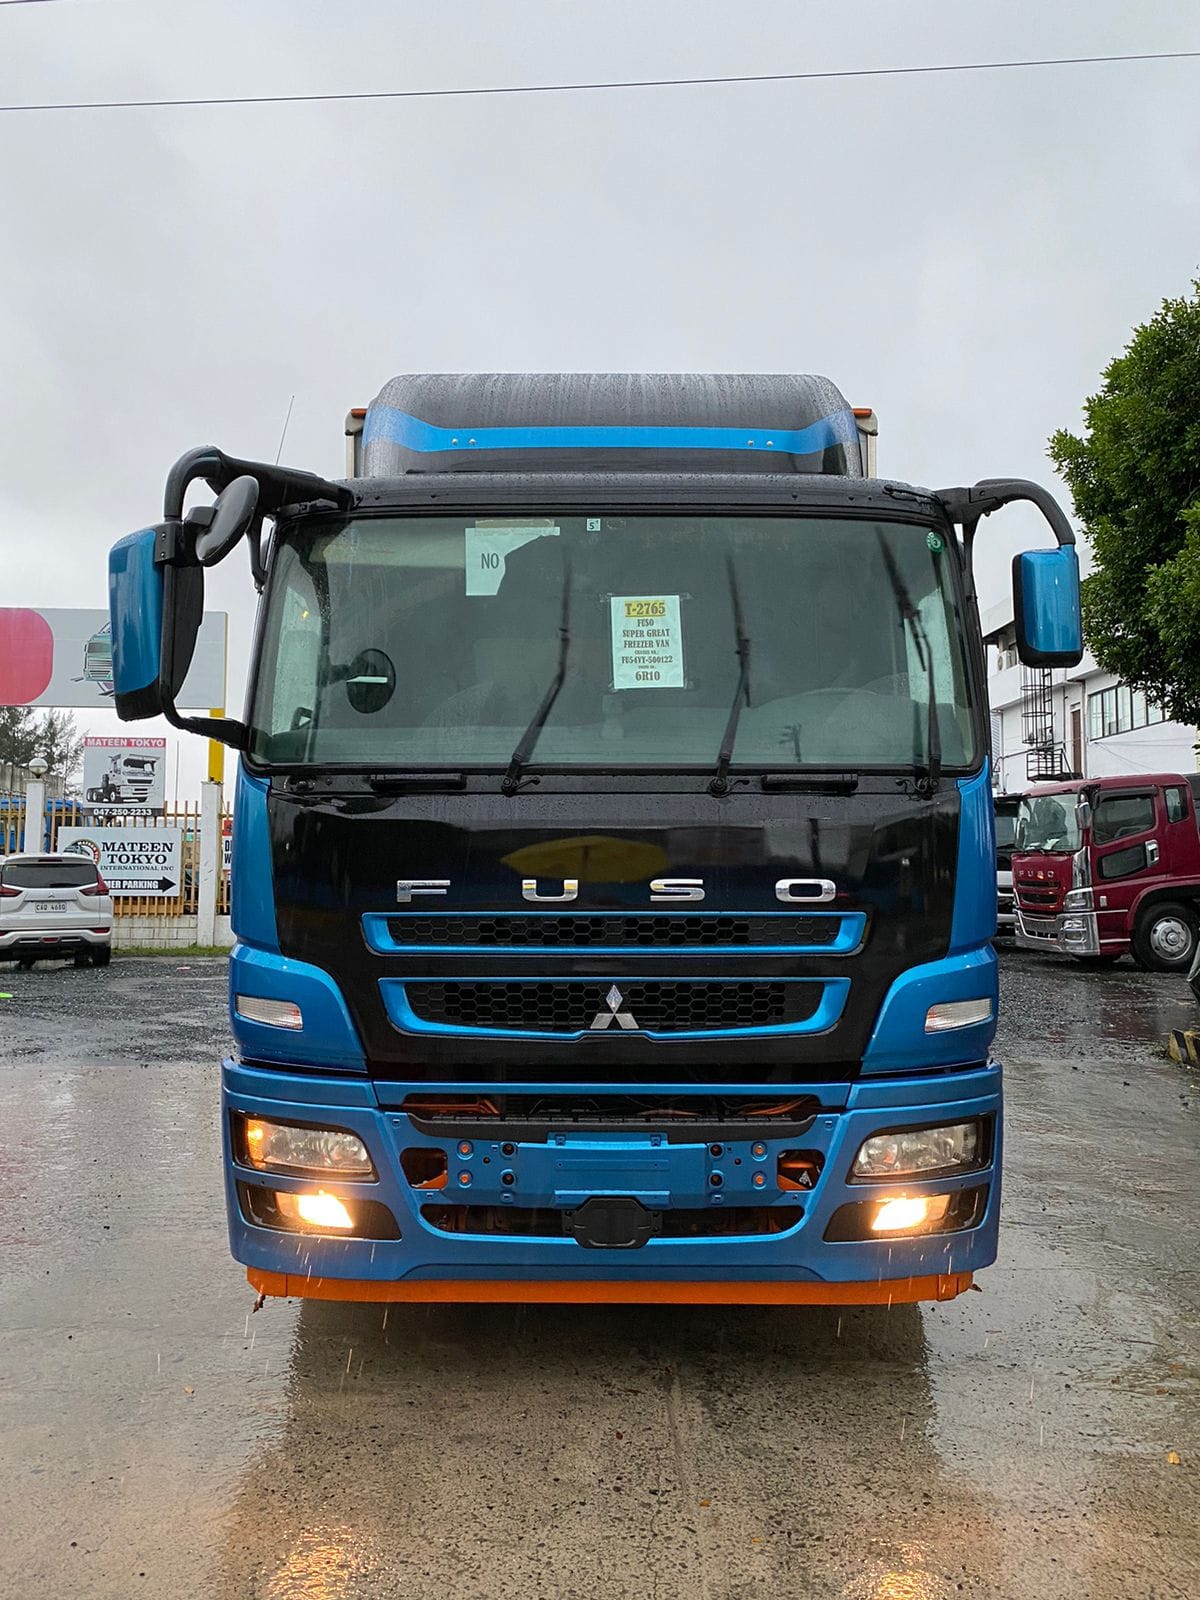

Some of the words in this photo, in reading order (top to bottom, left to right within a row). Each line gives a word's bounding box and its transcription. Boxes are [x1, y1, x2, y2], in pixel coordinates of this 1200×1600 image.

[481, 553, 500, 569] NO
[625, 602, 666, 615] T-2765
[637, 618, 655, 627] FUSO
[622, 629, 645, 638] SUPER
[646, 628, 670, 638] GREAT
[623, 640, 654, 649] FREEZER
[655, 639, 670, 648] VAN
[635, 670, 661, 681] 6R10
[87, 738, 128, 748] MATEEN
[129, 738, 164, 748] TOKYO
[93, 808, 152, 816] 047-250-2233
[101, 842, 174, 852] MATEEN
[107, 854, 167, 864] TOKYO
[122, 880, 159, 889] PARKING
[397, 879, 837, 902] FUSO
